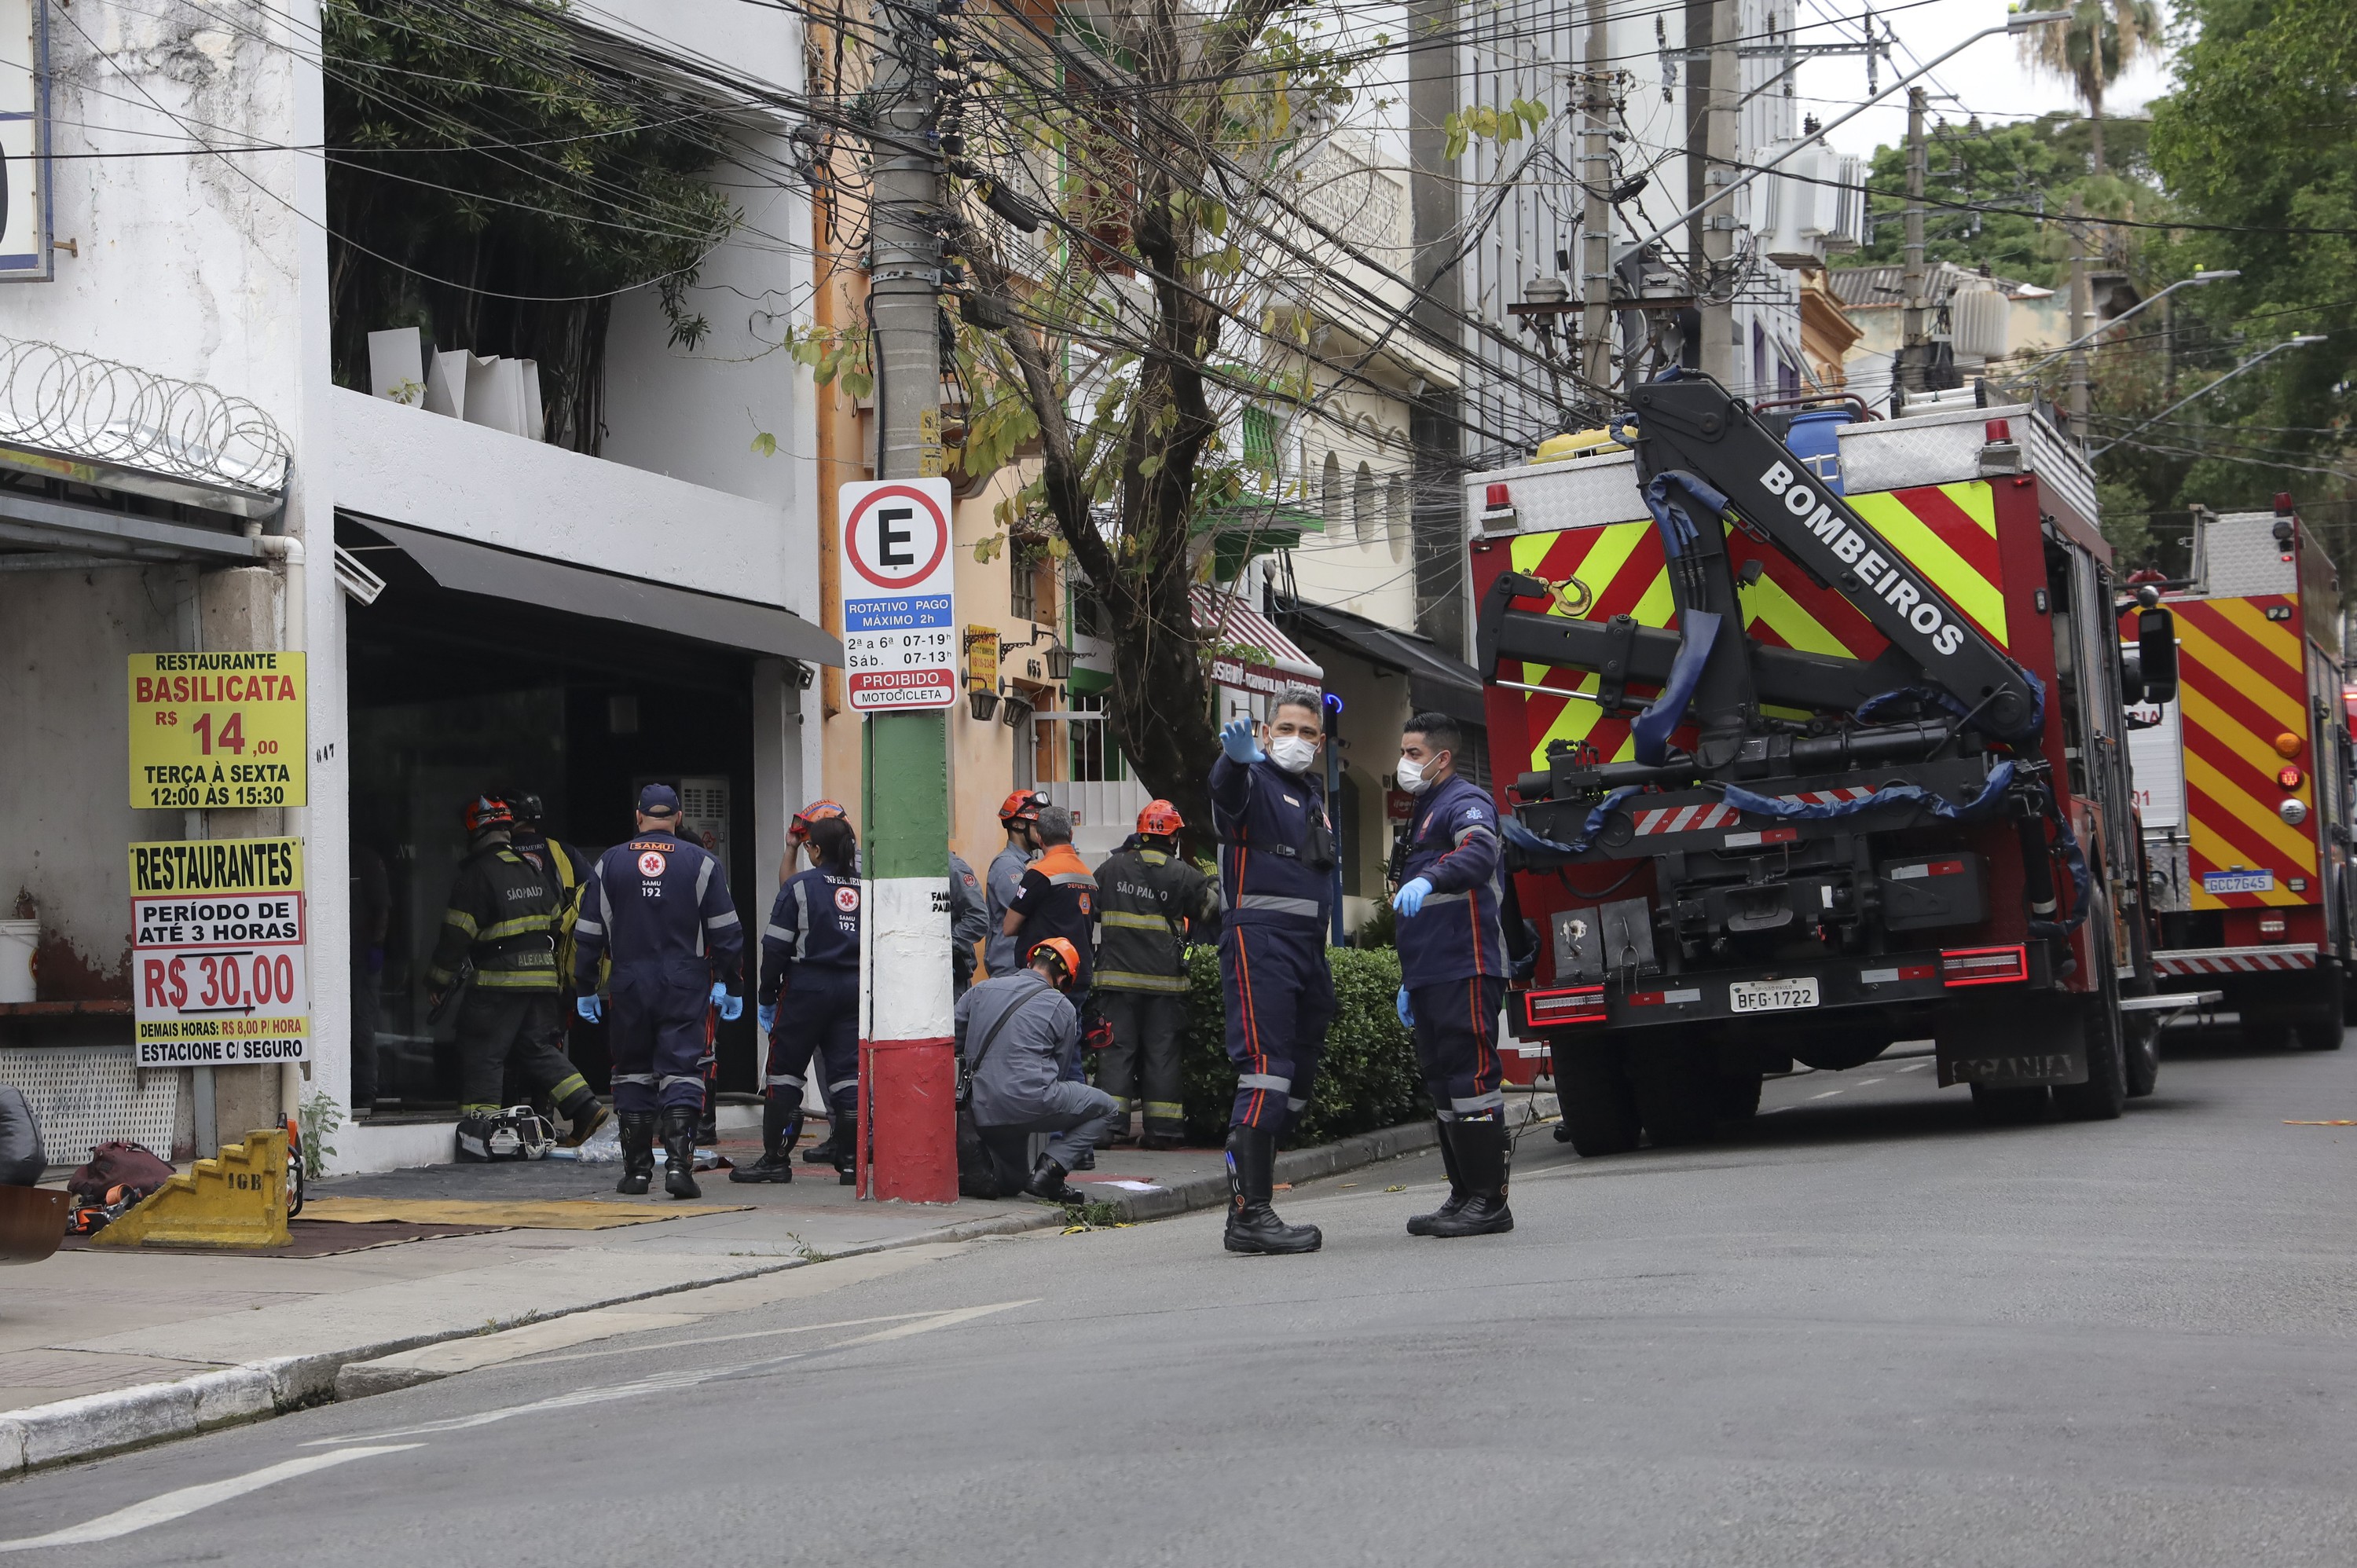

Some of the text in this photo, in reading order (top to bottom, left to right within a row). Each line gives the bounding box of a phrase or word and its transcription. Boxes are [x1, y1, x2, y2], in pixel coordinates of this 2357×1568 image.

[878, 508, 914, 566] E
[1759, 460, 1964, 655] BOMBEIROS
[849, 599, 949, 614] ROTATIVO PAGO
[863, 614, 934, 626] MÁXIMO 2h
[867, 640, 874, 649] a
[156, 653, 277, 670] RESTAURANTE
[849, 655, 884, 668] Sáb.
[1027, 658, 1041, 679] 653
[136, 675, 296, 702] BASILICATA
[863, 672, 939, 687] PROIBIDO
[862, 690, 942, 702] MOTOCICLETA
[156, 711, 178, 727] R$
[145, 761, 290, 787] TERÇA À SEXTA
[151, 783, 284, 806] 12:00 ÀS 15:30
[1149, 819, 1164, 831] 16
[136, 842, 293, 890] RESTAURANTES
[642, 888, 661, 896] 192
[1116, 881, 1168, 901] SÃO PAUO
[2210, 877, 2266, 891] GCC7G45
[507, 887, 522, 901] SÃO
[143, 902, 289, 922] PERÍODO DE
[139, 922, 297, 943] ATÉ 3 HORAS
[839, 921, 856, 932] 192
[144, 954, 294, 1017] R$ 30,00
[141, 1019, 302, 1038] DEMAIS HORAS: R$ 8,00 P/ HORA
[141, 1039, 302, 1061] ESTACIONE C/ SEGURO
